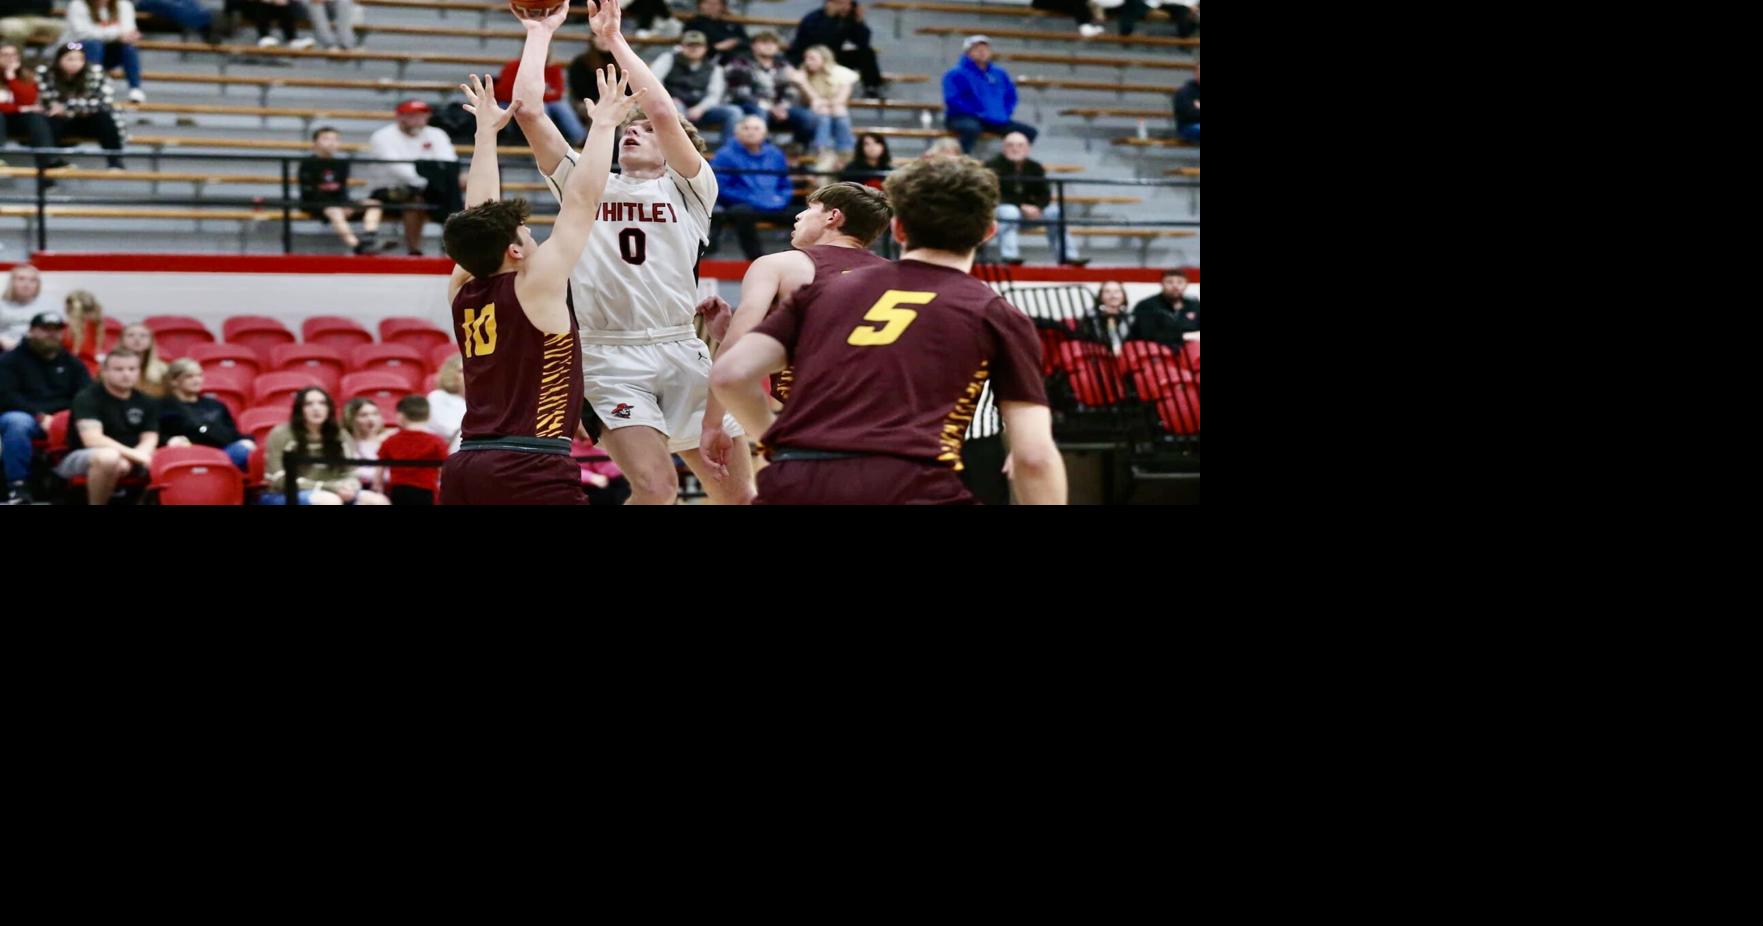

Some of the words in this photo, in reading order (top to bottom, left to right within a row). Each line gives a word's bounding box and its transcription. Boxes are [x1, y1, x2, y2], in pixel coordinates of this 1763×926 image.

[595, 202, 677, 223] HITLEY
[618, 227, 646, 266] 0
[462, 302, 497, 358] 10
[847, 289, 938, 346] 5
